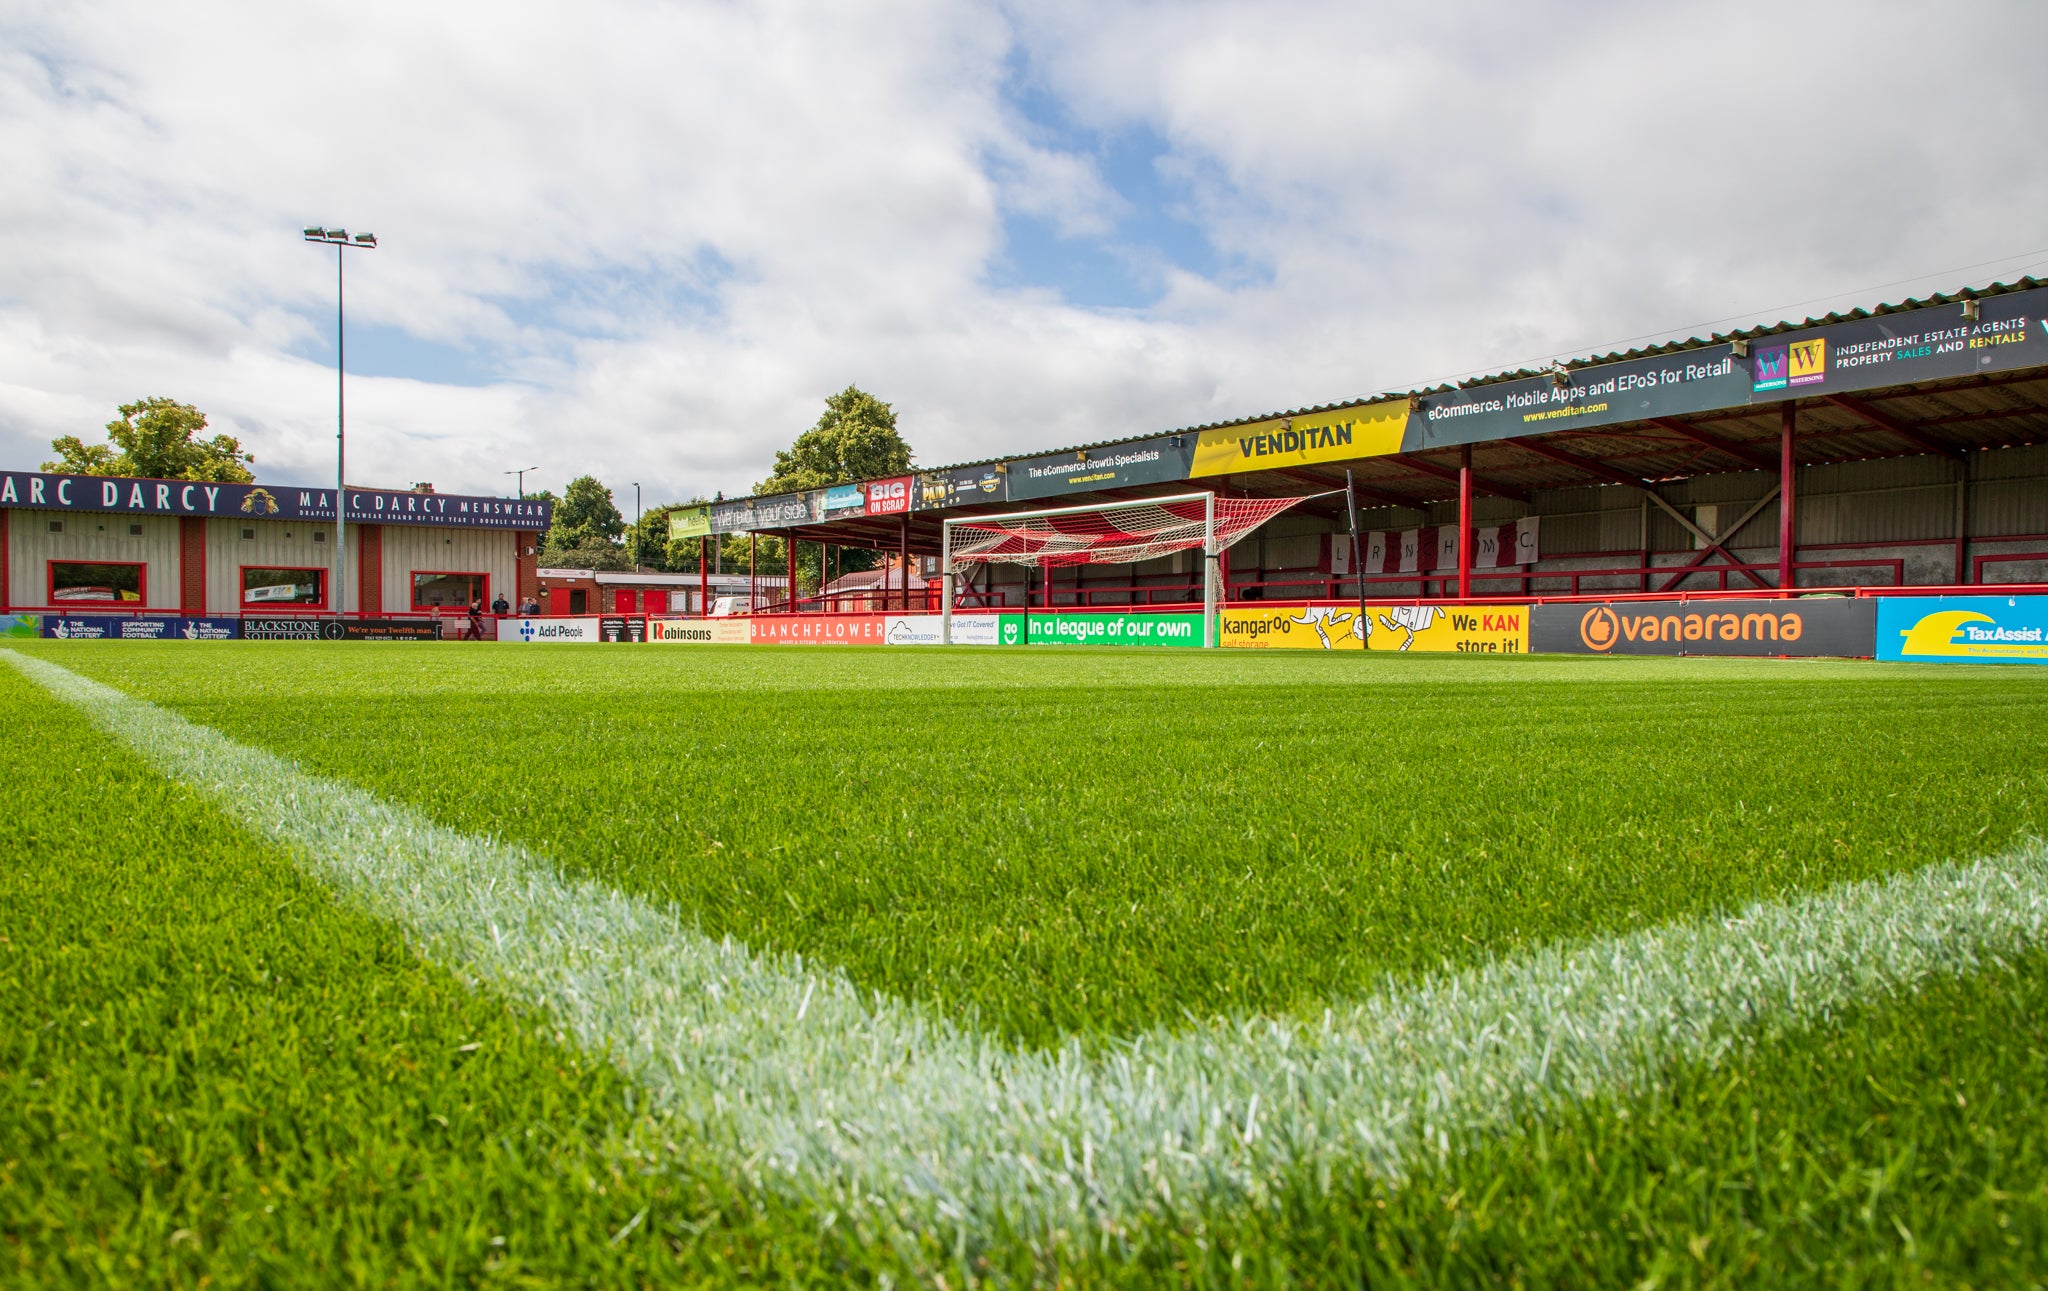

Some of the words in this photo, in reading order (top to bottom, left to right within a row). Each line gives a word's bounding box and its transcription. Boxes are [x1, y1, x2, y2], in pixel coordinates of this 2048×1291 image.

[1836, 334, 1919, 356] INDEPENDENT
[1924, 327, 1968, 343] ESTATE
[1972, 317, 2025, 335] AGENTS
[1792, 343, 1821, 371] W
[1836, 351, 1893, 369] PROPERTY
[1897, 346, 1931, 360] SALES
[1936, 341, 1964, 354] AND
[1969, 331, 2025, 349] RENTALS
[1757, 349, 1785, 376] W
[1790, 374, 1824, 384] WATERSONS
[1428, 398, 1504, 421] eCommerce,
[1506, 388, 1548, 408] Mobile
[1551, 383, 1586, 402] Apps
[1588, 372, 1615, 395] and
[1618, 371, 1657, 391] EPoS
[1660, 363, 1682, 385] for
[1686, 358, 1731, 380] Retail
[1523, 401, 1608, 423] www.venditan.com
[1239, 423, 1352, 458] VENDITAN
[1029, 467, 1042, 478] The
[1043, 461, 1086, 476] eCommerce
[1087, 457, 1114, 470] Growth
[1115, 450, 1159, 468] Specialists
[1068, 472, 1116, 484] www.venditan.com
[102, 481, 219, 511] DARCY
[870, 482, 905, 501] BIG
[922, 485, 946, 501] PAID
[300, 491, 360, 510] MAC
[375, 495, 445, 513] DARCY
[460, 501, 543, 516] MENSWEAR
[784, 502, 806, 519] side
[870, 502, 881, 513] ON
[882, 498, 905, 512] SCRAP
[244, 621, 320, 631] BLACKSTONE
[653, 622, 712, 641] Robinsons
[751, 623, 883, 637] BLANCHFLOWER
[1003, 623, 1018, 635] ao
[1029, 618, 1041, 634] In
[1044, 623, 1053, 635] a
[1056, 618, 1105, 640] league
[1107, 618, 1125, 636] of
[1126, 620, 1153, 636] our
[1157, 622, 1191, 637] own
[1223, 616, 1291, 639] kangaroo
[1452, 614, 1477, 631] We
[1483, 614, 1519, 631] KAN
[1621, 613, 1802, 641] vanarama
[244, 632, 320, 640] SOLICITORS
[538, 625, 557, 638] Add
[558, 626, 583, 640] People
[1967, 627, 2042, 641] TaxAssist
[1222, 640, 1237, 648] self
[1238, 640, 1269, 648] storage
[1456, 640, 1497, 653] store
[1503, 638, 1519, 653] it!
